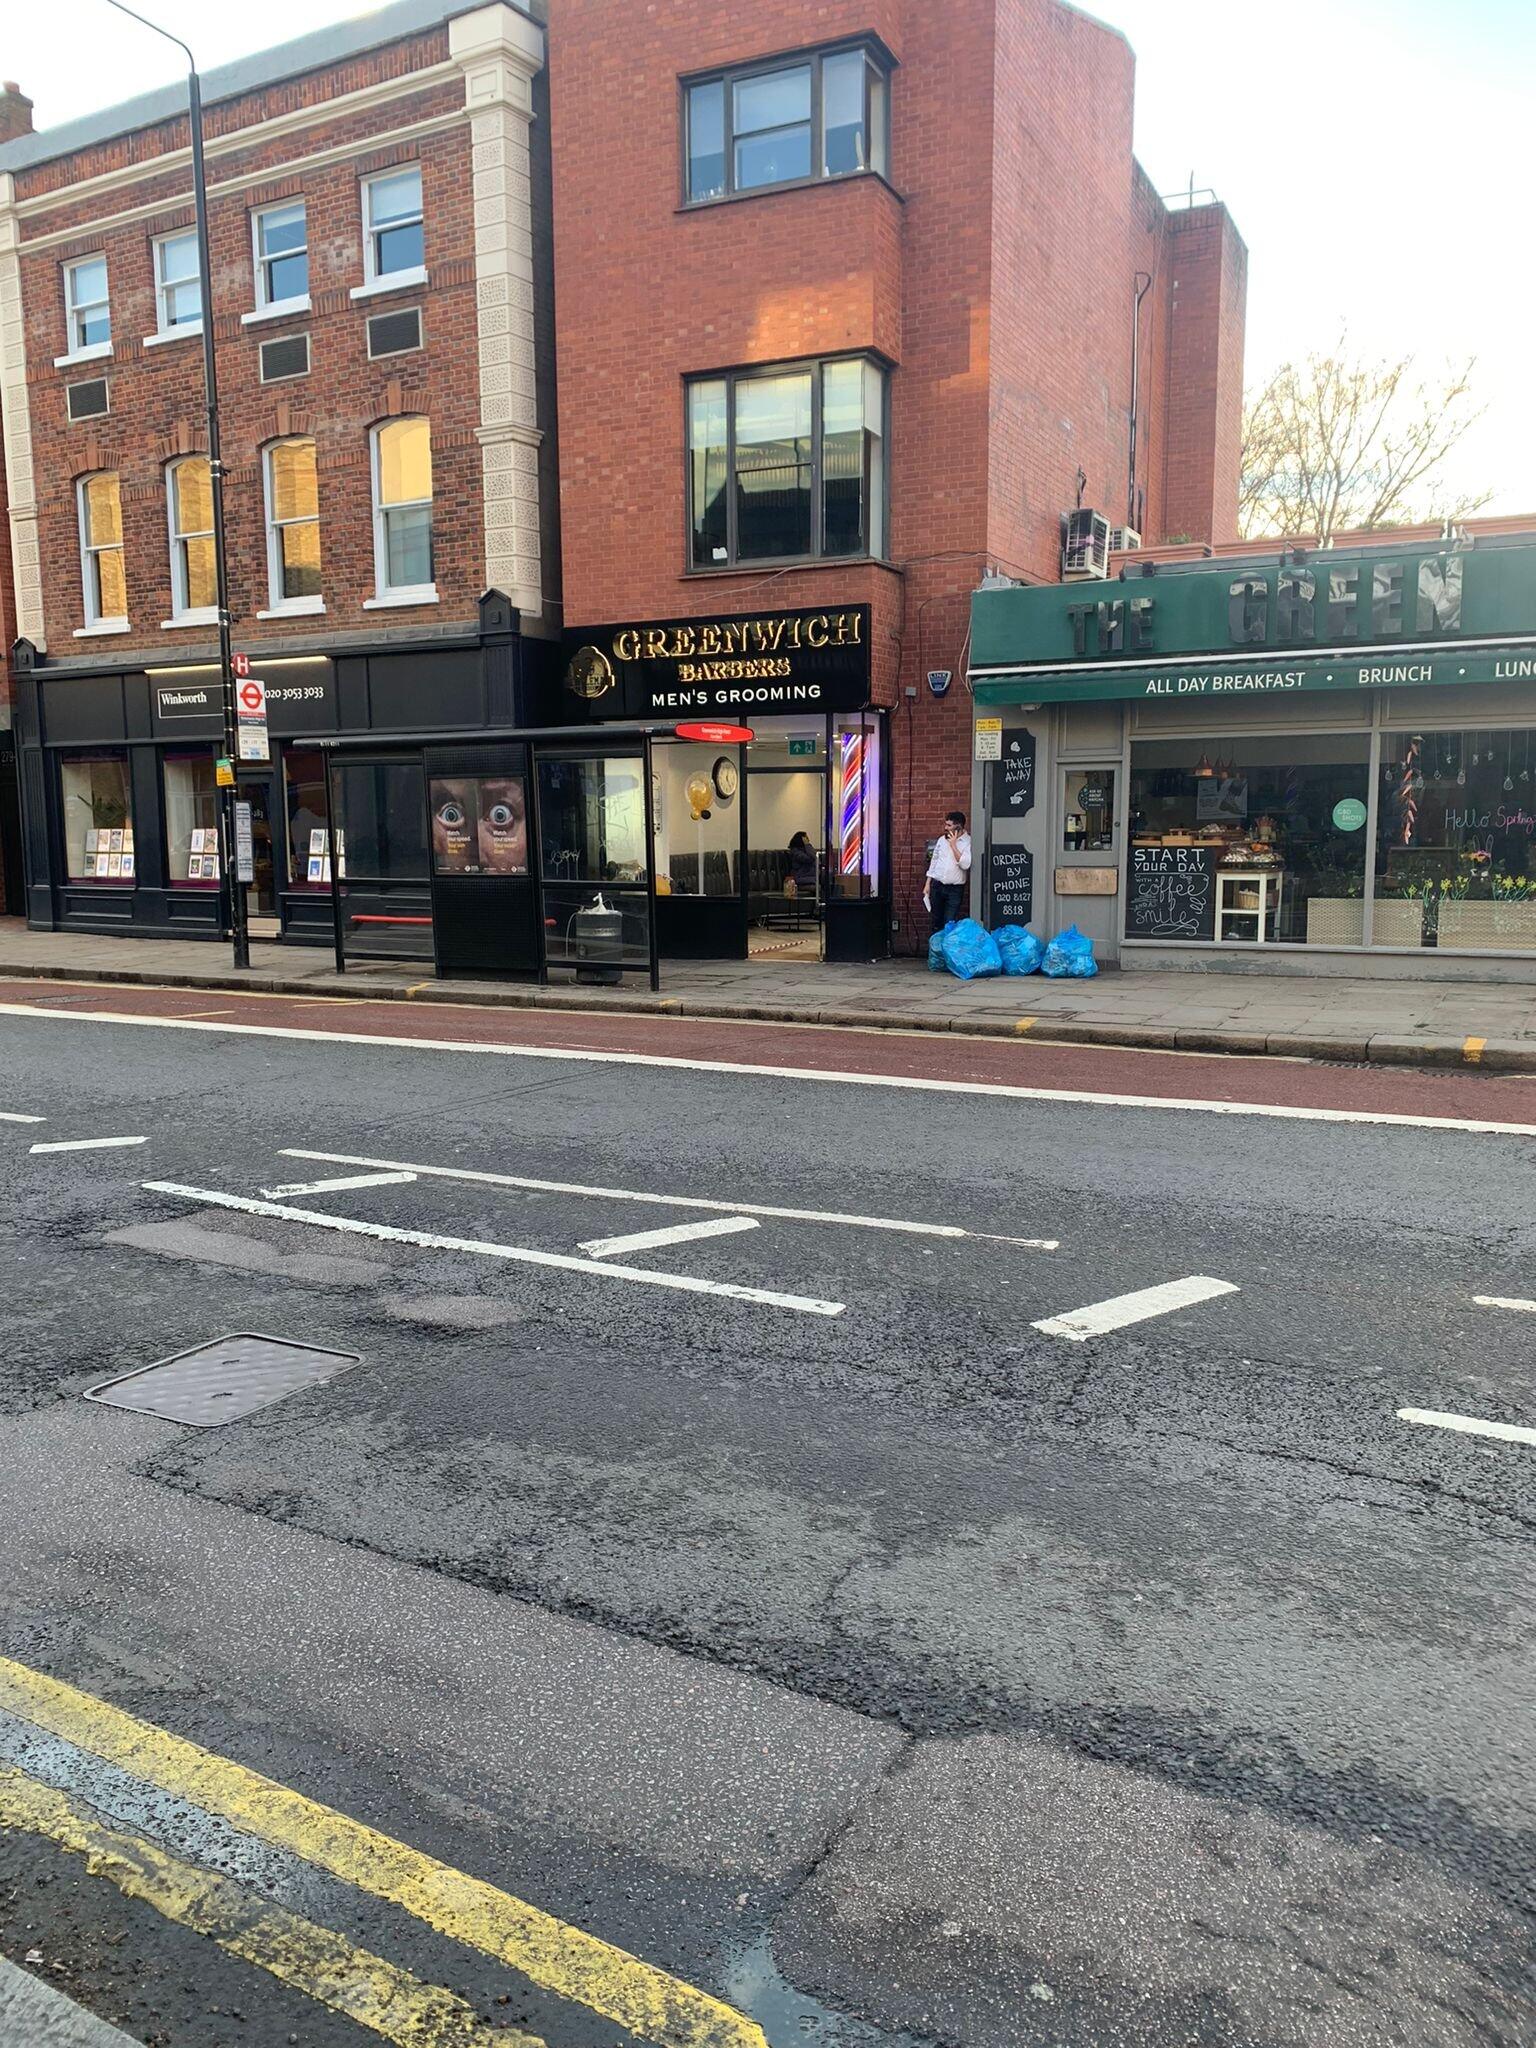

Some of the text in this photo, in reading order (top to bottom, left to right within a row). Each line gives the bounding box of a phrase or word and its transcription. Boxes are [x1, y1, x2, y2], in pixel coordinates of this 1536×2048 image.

[1068, 558, 1464, 653] THE GREEN
[613, 613, 862, 661] GREENWICH
[236, 658, 250, 675] H
[679, 658, 791, 682] BARBERS
[1358, 665, 1433, 684] BRUNCH
[1145, 671, 1306, 694] ALL DAY BREAKFAST
[162, 692, 207, 705] Winkworth
[265, 686, 324, 700] 020 3053 3033
[651, 684, 822, 707] MEN'S GROOMING
[1003, 757, 1032, 770] TAKE
[1005, 768, 1031, 783] AWAY
[1445, 806, 1534, 834] Hello Spring
[993, 853, 1029, 866] ORDER
[1135, 849, 1205, 862] START
[1007, 867, 1021, 877] BY
[1135, 863, 1205, 872] YOUR DAY
[994, 878, 1030, 892] PHONE
[1138, 876, 1197, 903] coffee
[997, 894, 1011, 902] 020
[1003, 905, 1024, 915] 8818
